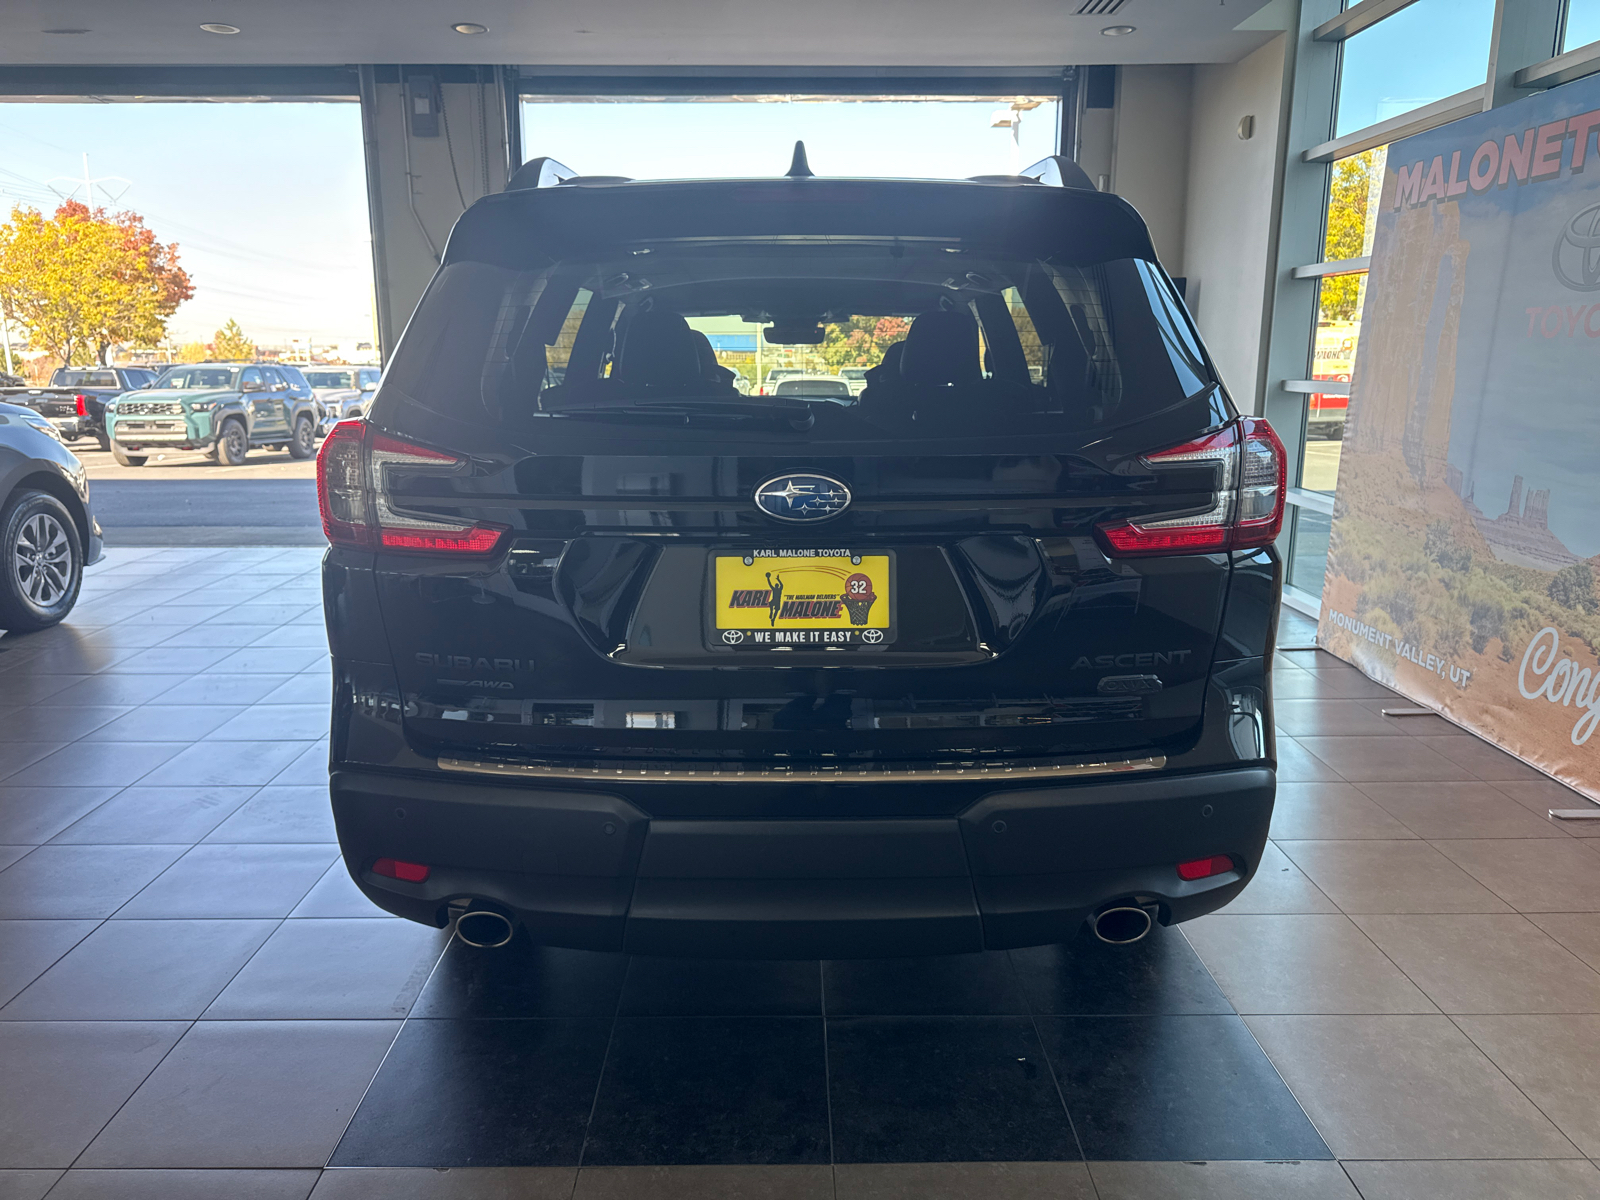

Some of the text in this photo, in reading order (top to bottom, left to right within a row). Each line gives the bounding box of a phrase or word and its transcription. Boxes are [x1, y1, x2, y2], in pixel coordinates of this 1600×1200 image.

[1394, 108, 1600, 212] MALONET
[753, 549, 850, 557] KARL MALONE TOYOTA
[850, 580, 867, 594] 32
[729, 590, 772, 608] KARL
[779, 601, 843, 619] MALONE
[754, 631, 851, 642] WE MAKE IT EASY
[1328, 608, 1471, 687] MONUMENT VALLEY, UT
[414, 652, 535, 671] SUBARU
[1070, 649, 1192, 670] ASCENT
[465, 680, 514, 689] AWD
